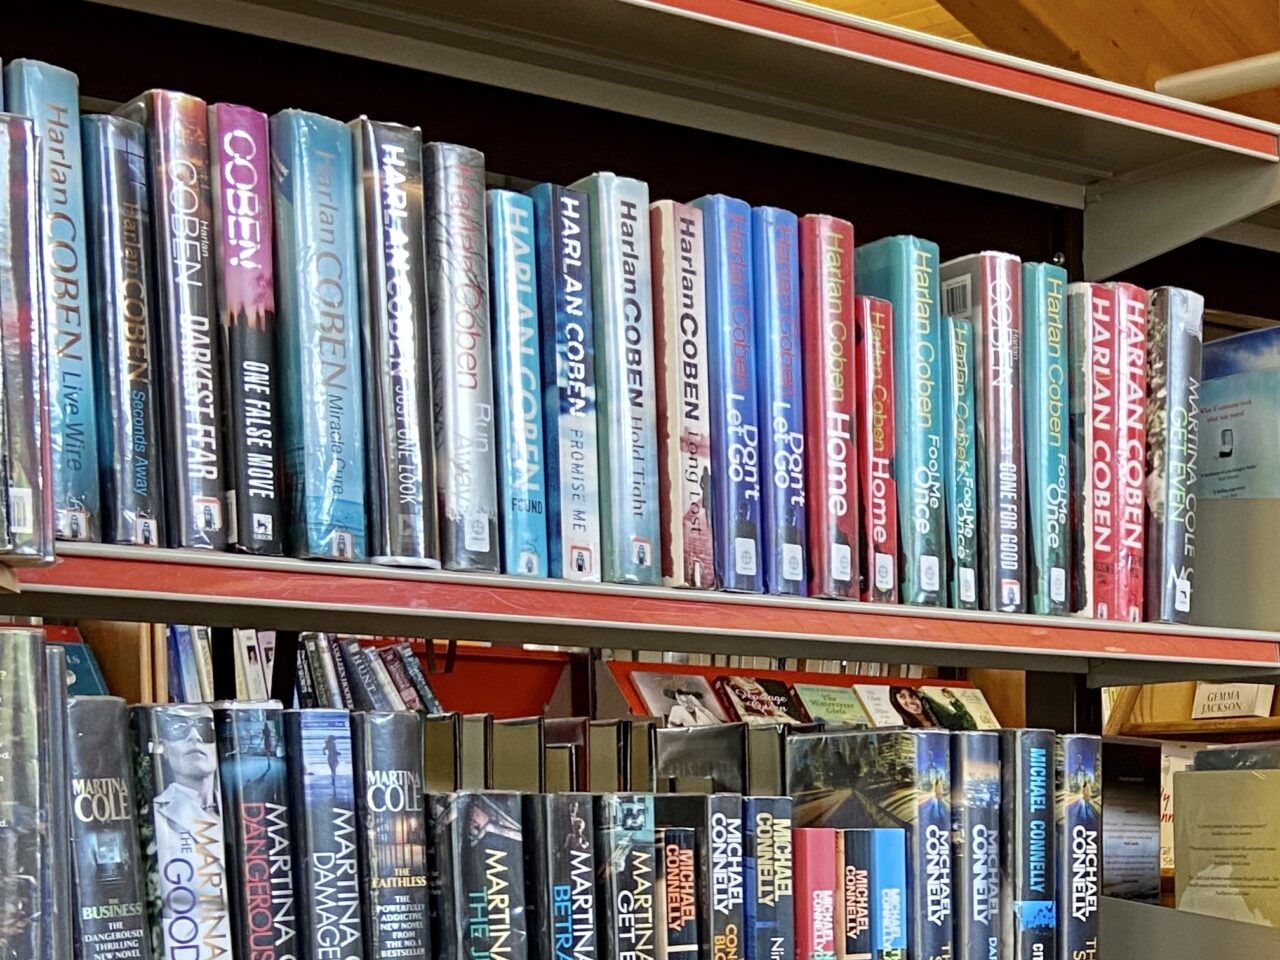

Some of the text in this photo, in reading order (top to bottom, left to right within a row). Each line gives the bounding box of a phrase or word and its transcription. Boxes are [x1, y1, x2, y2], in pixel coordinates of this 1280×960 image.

[223, 129, 263, 270] COBEN
[45, 101, 83, 472] Harlan COBEN Live Wire
[122, 200, 147, 496] Harlan COBEN Seconds Away
[559, 197, 587, 532] HARLAN COBEN PROMISE ME
[620, 201, 645, 520] Harlan COBEN Hold Tight
[826, 231, 851, 518] Harlan Coben Home
[243, 361, 275, 499] ONE FALSE MOVE
[772, 401, 805, 508] Don't Let Go
[927, 434, 940, 509] Fool Me
[1090, 296, 1112, 553] HARLAN COBEN
[1169, 406, 1187, 523] GET EVEN
[1184, 377, 1199, 558] MARTINA COLE
[913, 465, 930, 535] Once
[1201, 702, 1242, 714] JACKSON
[1207, 690, 1240, 702] GEMMA
[72, 777, 129, 797] MARTINA
[74, 794, 131, 822] COLE
[1028, 747, 1046, 893] MICHAEL CONNELLY
[178, 830, 193, 856] THE
[265, 802, 295, 946] MARTINA
[332, 807, 361, 948] MARTINA
[756, 812, 775, 907] CONNELLY
[774, 818, 792, 903] MICHAEL
[82, 903, 142, 920] BUSINESS
[85, 929, 144, 943] DANGEROUSLY
[95, 940, 138, 951] THRILLING
[616, 890, 636, 943] GET
